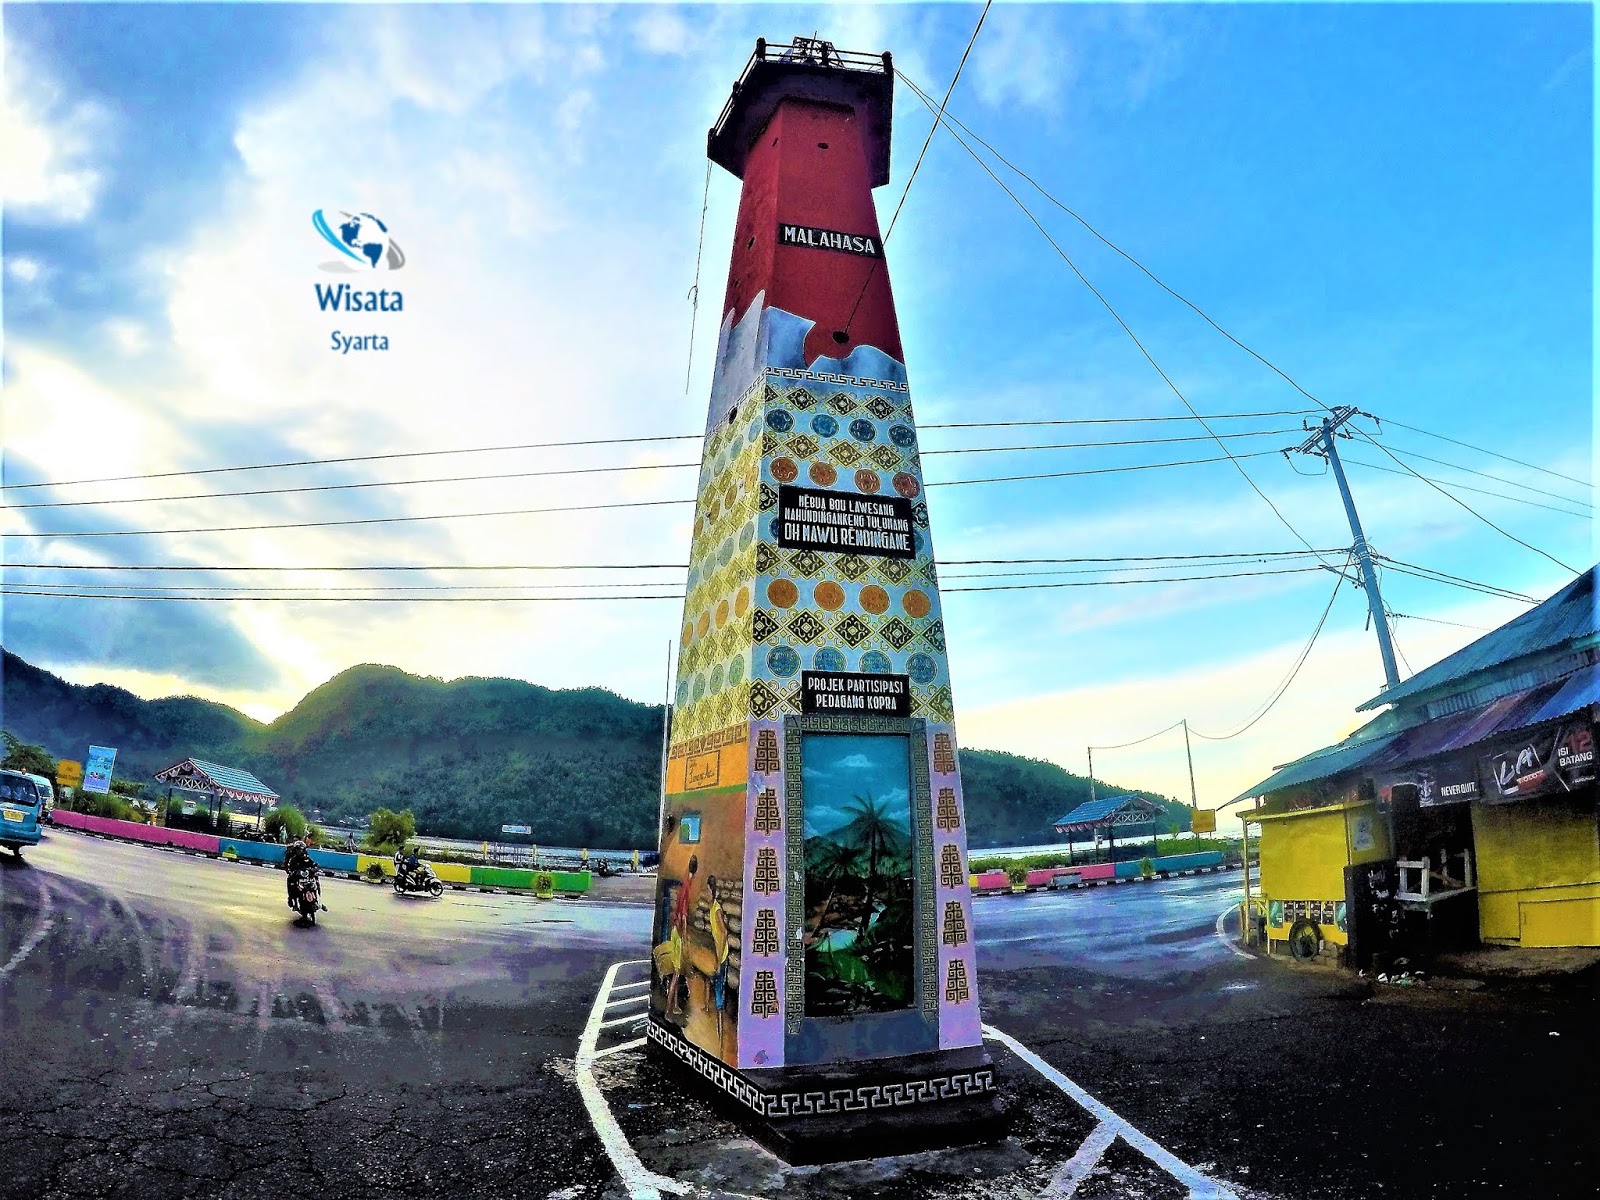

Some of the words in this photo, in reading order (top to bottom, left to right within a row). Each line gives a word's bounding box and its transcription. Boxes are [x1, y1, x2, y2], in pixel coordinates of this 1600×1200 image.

[784, 226, 875, 254] MALAHASA
[849, 500, 894, 516] LAWESANG
[784, 522, 800, 541] OH
[808, 677, 844, 692] PROJEK
[847, 679, 903, 694] PARTISIPASI
[816, 694, 864, 709] PEDAGANG
[867, 695, 897, 710] KOPRA
[1557, 746, 1569, 757] ISI
[1559, 751, 1593, 767] BATANG
[1441, 784, 1461, 797] NEVER
